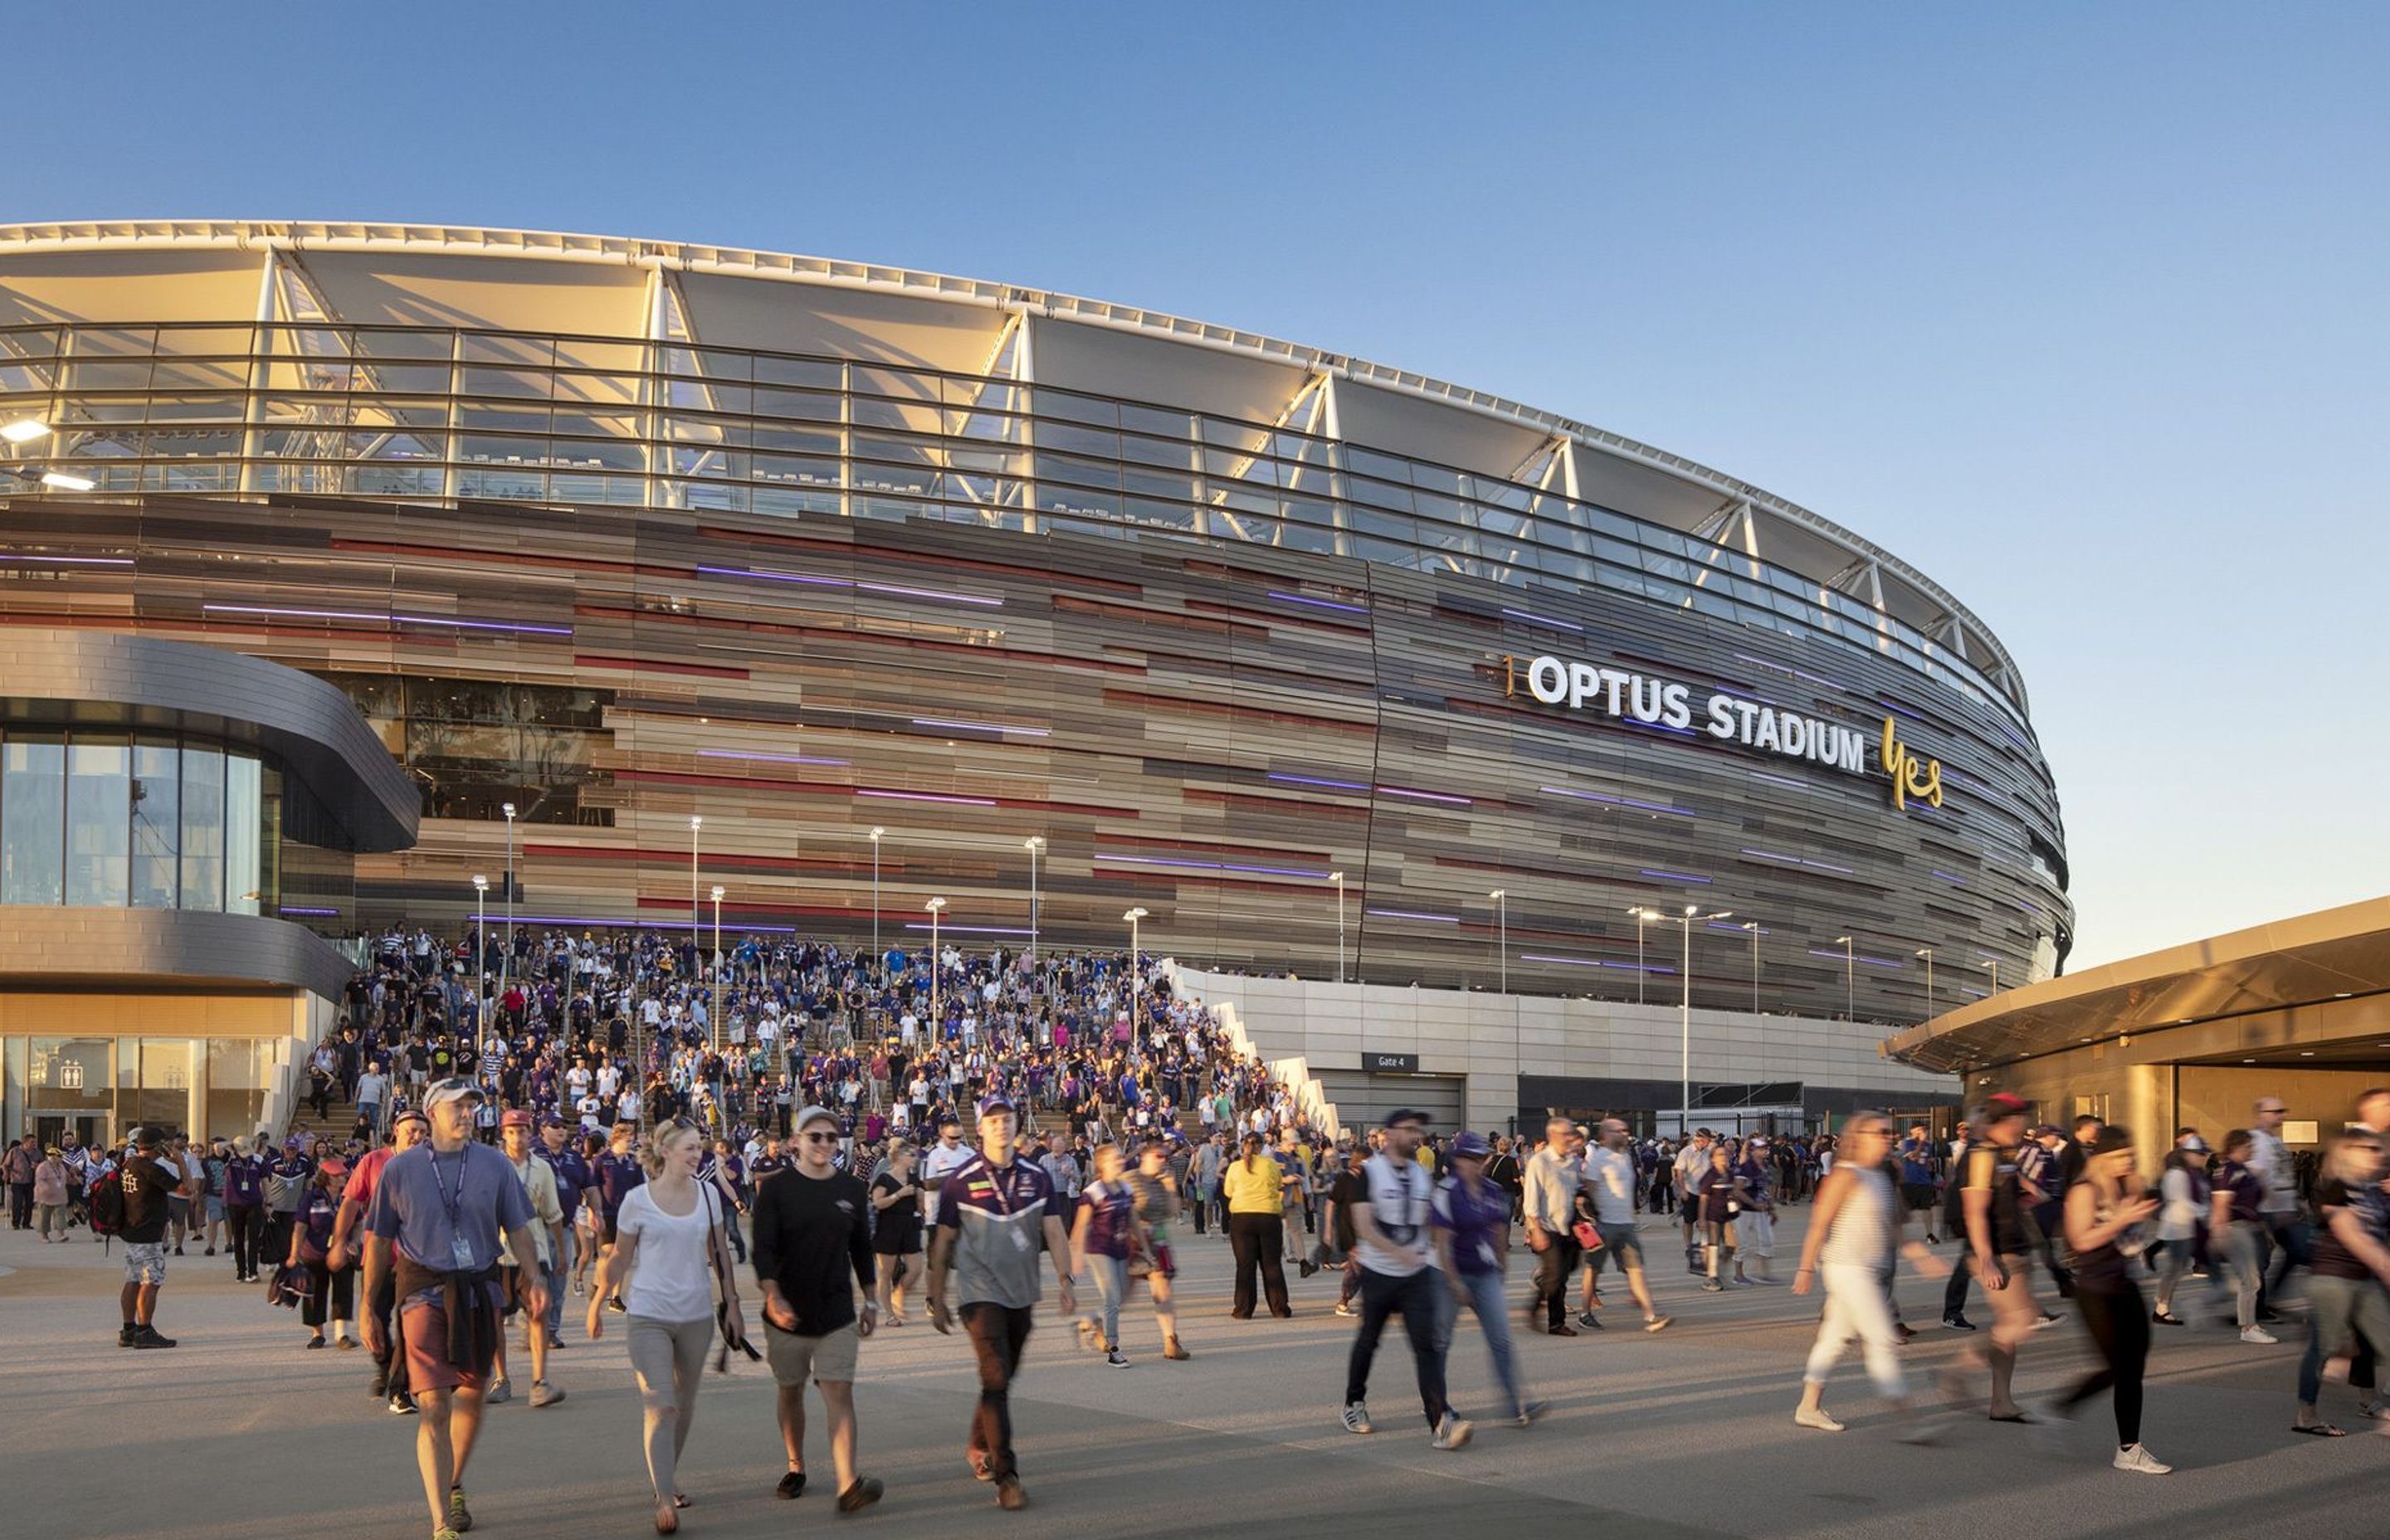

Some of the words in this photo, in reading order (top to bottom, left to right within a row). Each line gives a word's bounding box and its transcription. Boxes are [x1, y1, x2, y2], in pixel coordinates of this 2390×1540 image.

[1529, 655, 1690, 729] OPTUS
[1707, 694, 1864, 773] STADIUM
[1378, 1056, 1397, 1067] Gate
[1398, 1057, 1404, 1067] 4
